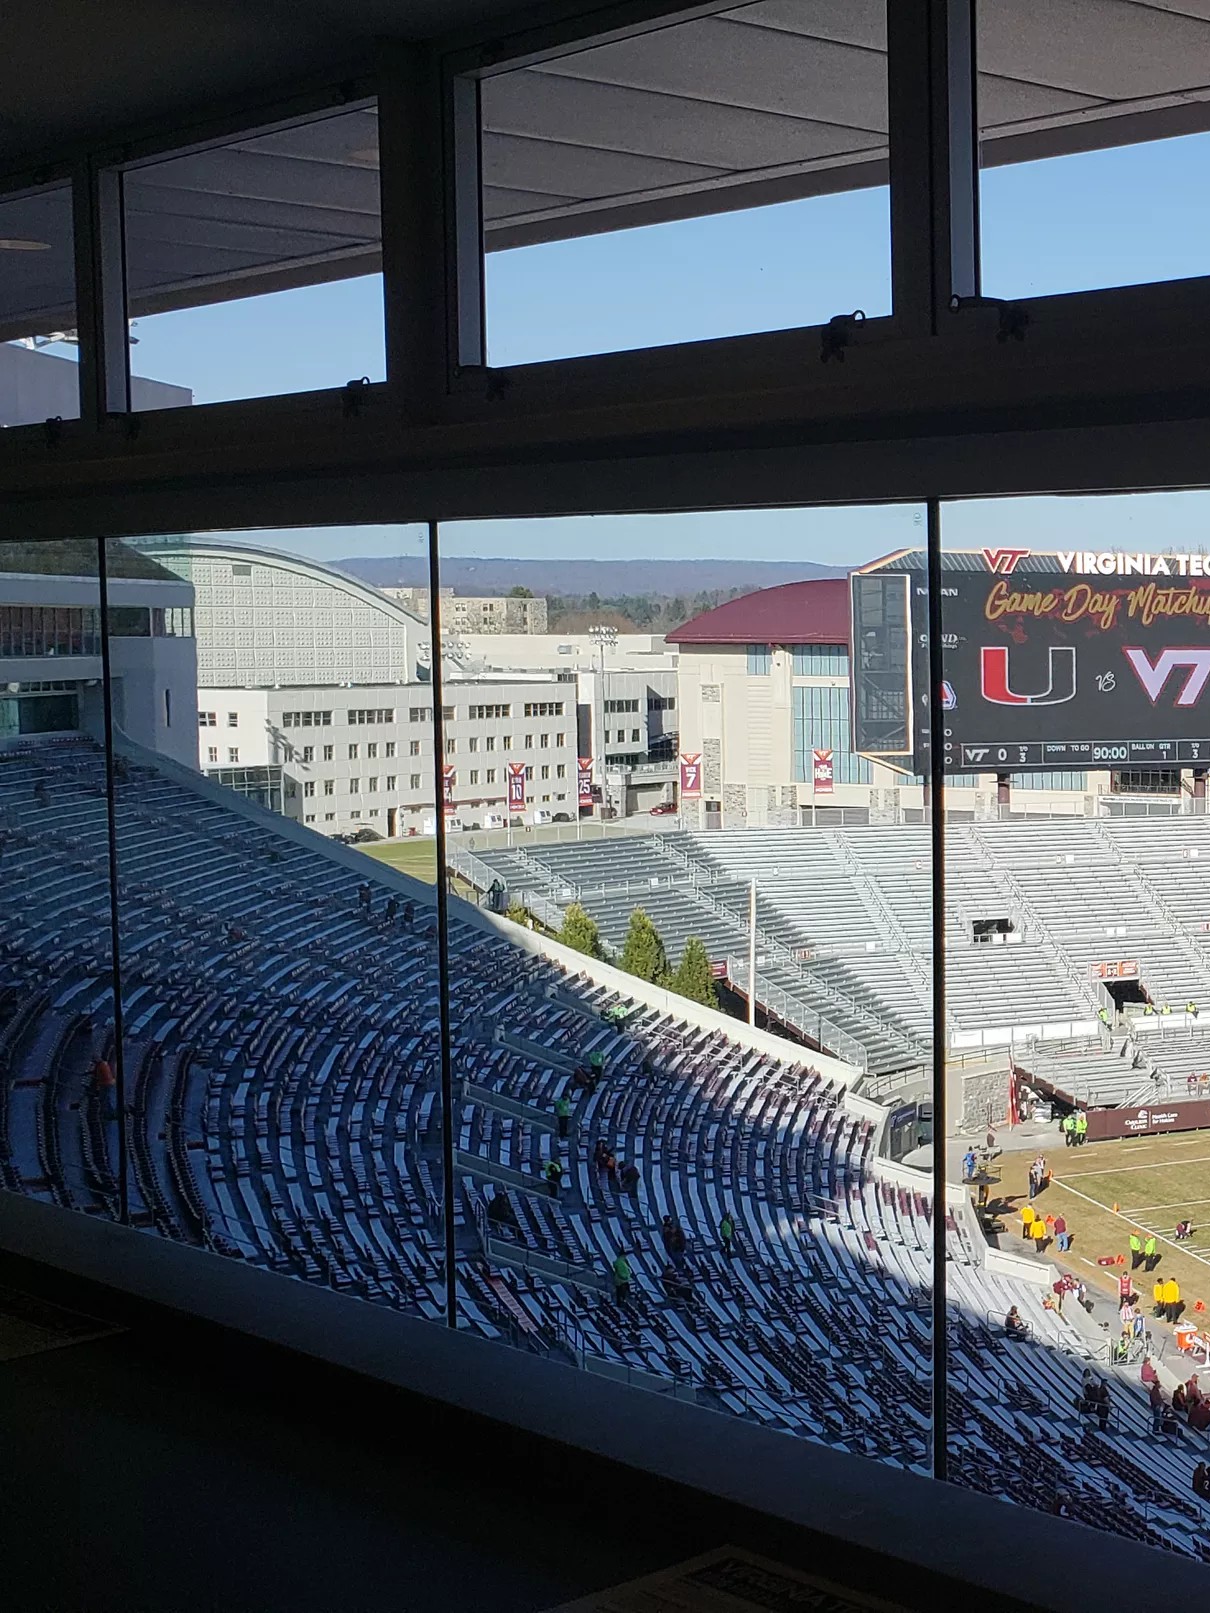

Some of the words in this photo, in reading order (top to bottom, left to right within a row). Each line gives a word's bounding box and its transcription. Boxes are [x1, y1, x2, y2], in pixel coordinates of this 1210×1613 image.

[981, 548, 1030, 575] VT
[1057, 551, 1171, 576] VIRGINIA
[985, 581, 1059, 620] Game
[1062, 584, 1119, 629] Day
[980, 646, 1076, 705] U
[965, 749, 989, 761] VT
[998, 748, 1007, 761] 0
[1019, 753, 1026, 763] 3
[1093, 746, 1127, 760] 90:00
[579, 779, 590, 794] 25
[686, 773, 697, 788] 7
[512, 783, 522, 800] 10
